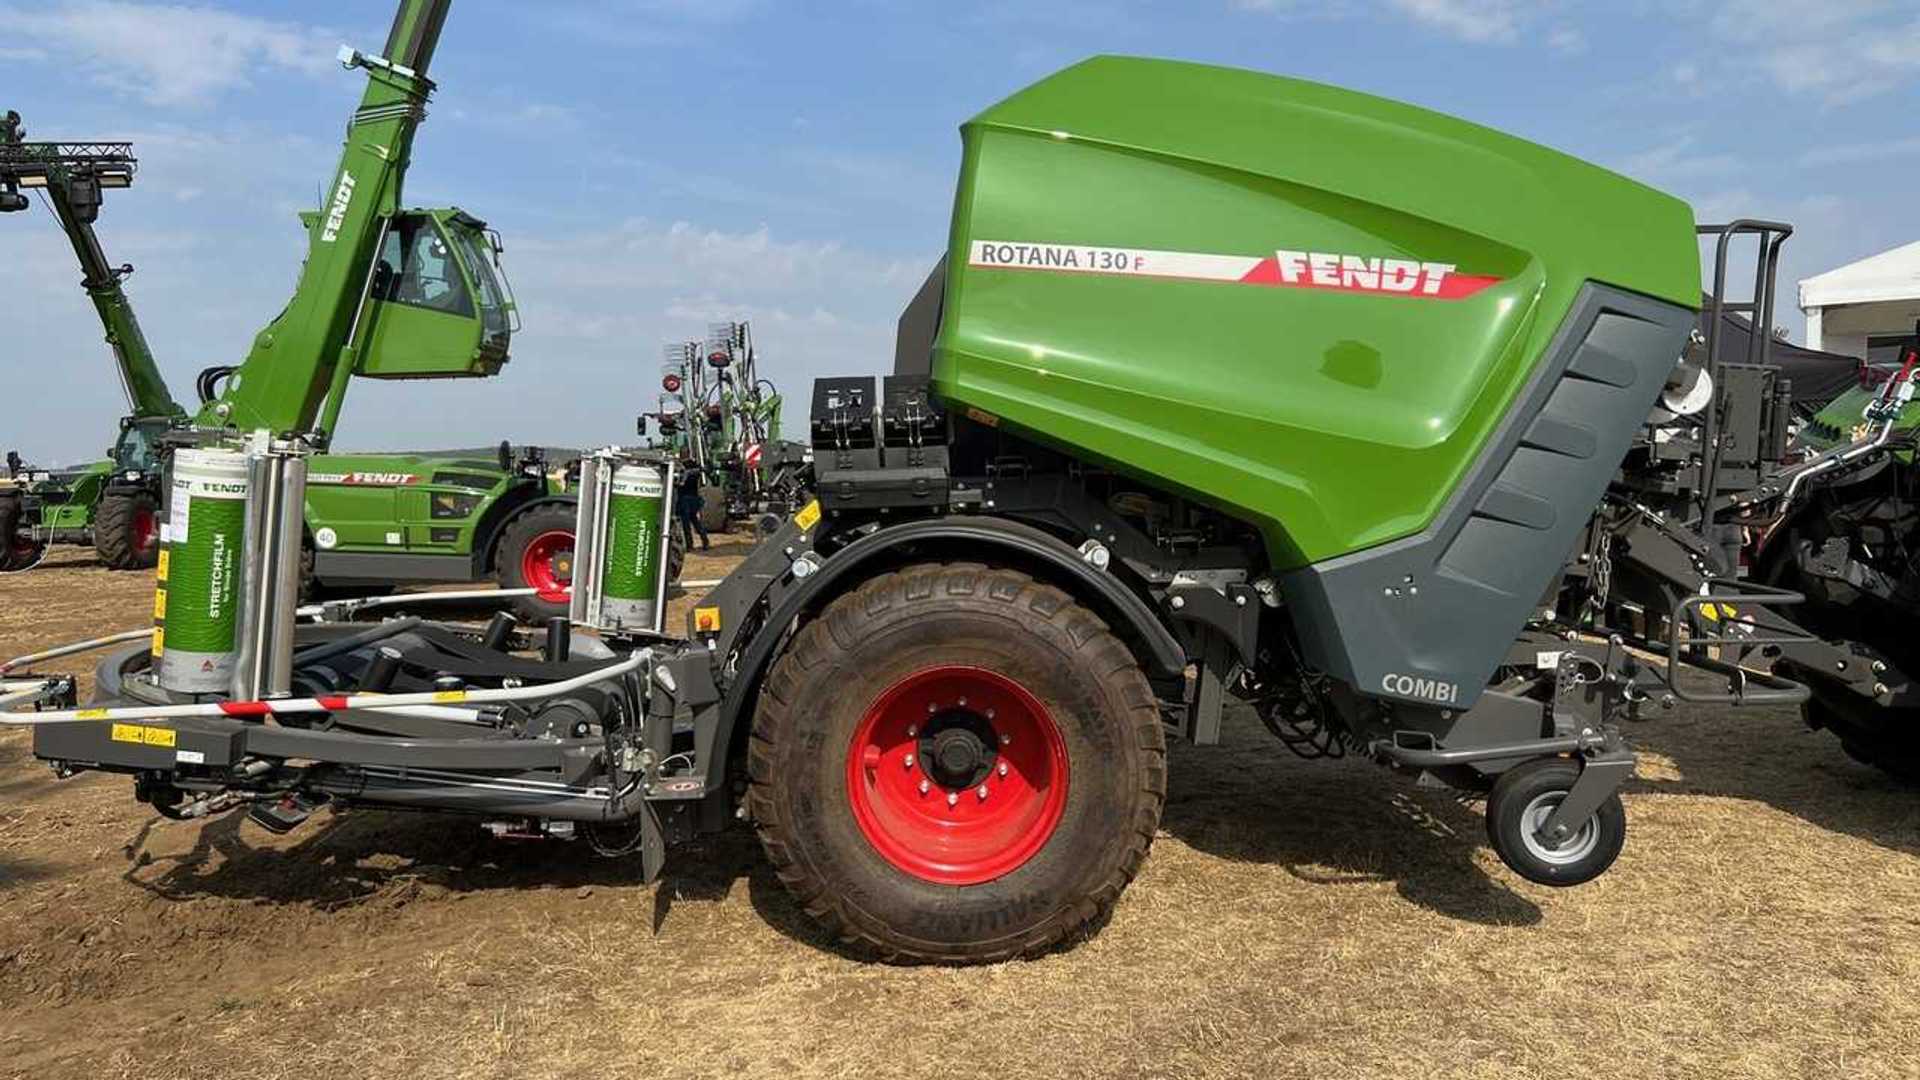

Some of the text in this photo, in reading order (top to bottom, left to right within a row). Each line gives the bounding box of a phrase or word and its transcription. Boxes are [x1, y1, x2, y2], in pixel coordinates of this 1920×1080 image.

[321, 170, 356, 242] FENDT
[981, 244, 1144, 271] ROTANA 130 F
[1275, 250, 1457, 294] FENDT
[202, 482, 248, 494] FENDT
[352, 472, 415, 484] FENDT
[319, 532, 334, 544] 40
[209, 533, 226, 619] STRETCHFILM
[1382, 673, 1458, 703] COMBI
